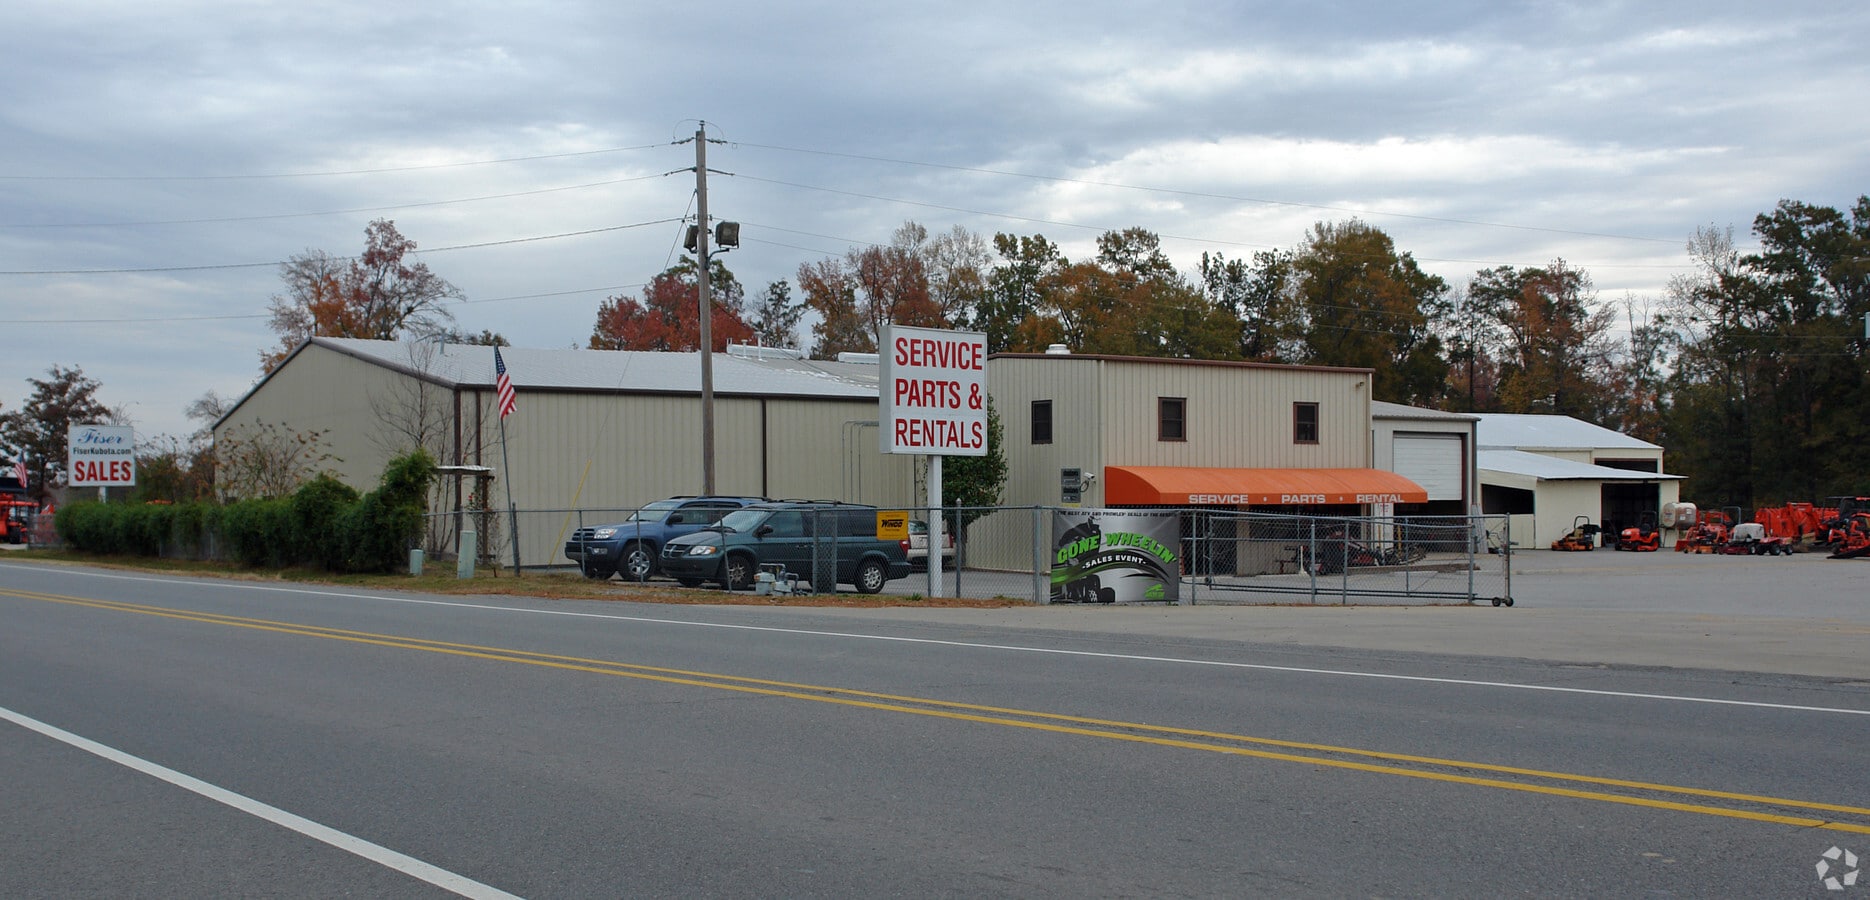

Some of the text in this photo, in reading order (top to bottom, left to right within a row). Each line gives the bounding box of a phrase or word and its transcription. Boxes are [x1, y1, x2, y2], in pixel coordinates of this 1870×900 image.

[895, 337, 983, 370] SERVICE
[895, 378, 983, 410] PARTS &
[77, 428, 122, 444] Fiser
[895, 418, 983, 449] RENTALS
[74, 460, 132, 482] SALES
[1188, 494, 1405, 504] SERVICE PARTS RENTAL
[1057, 534, 1100, 564] GONE
